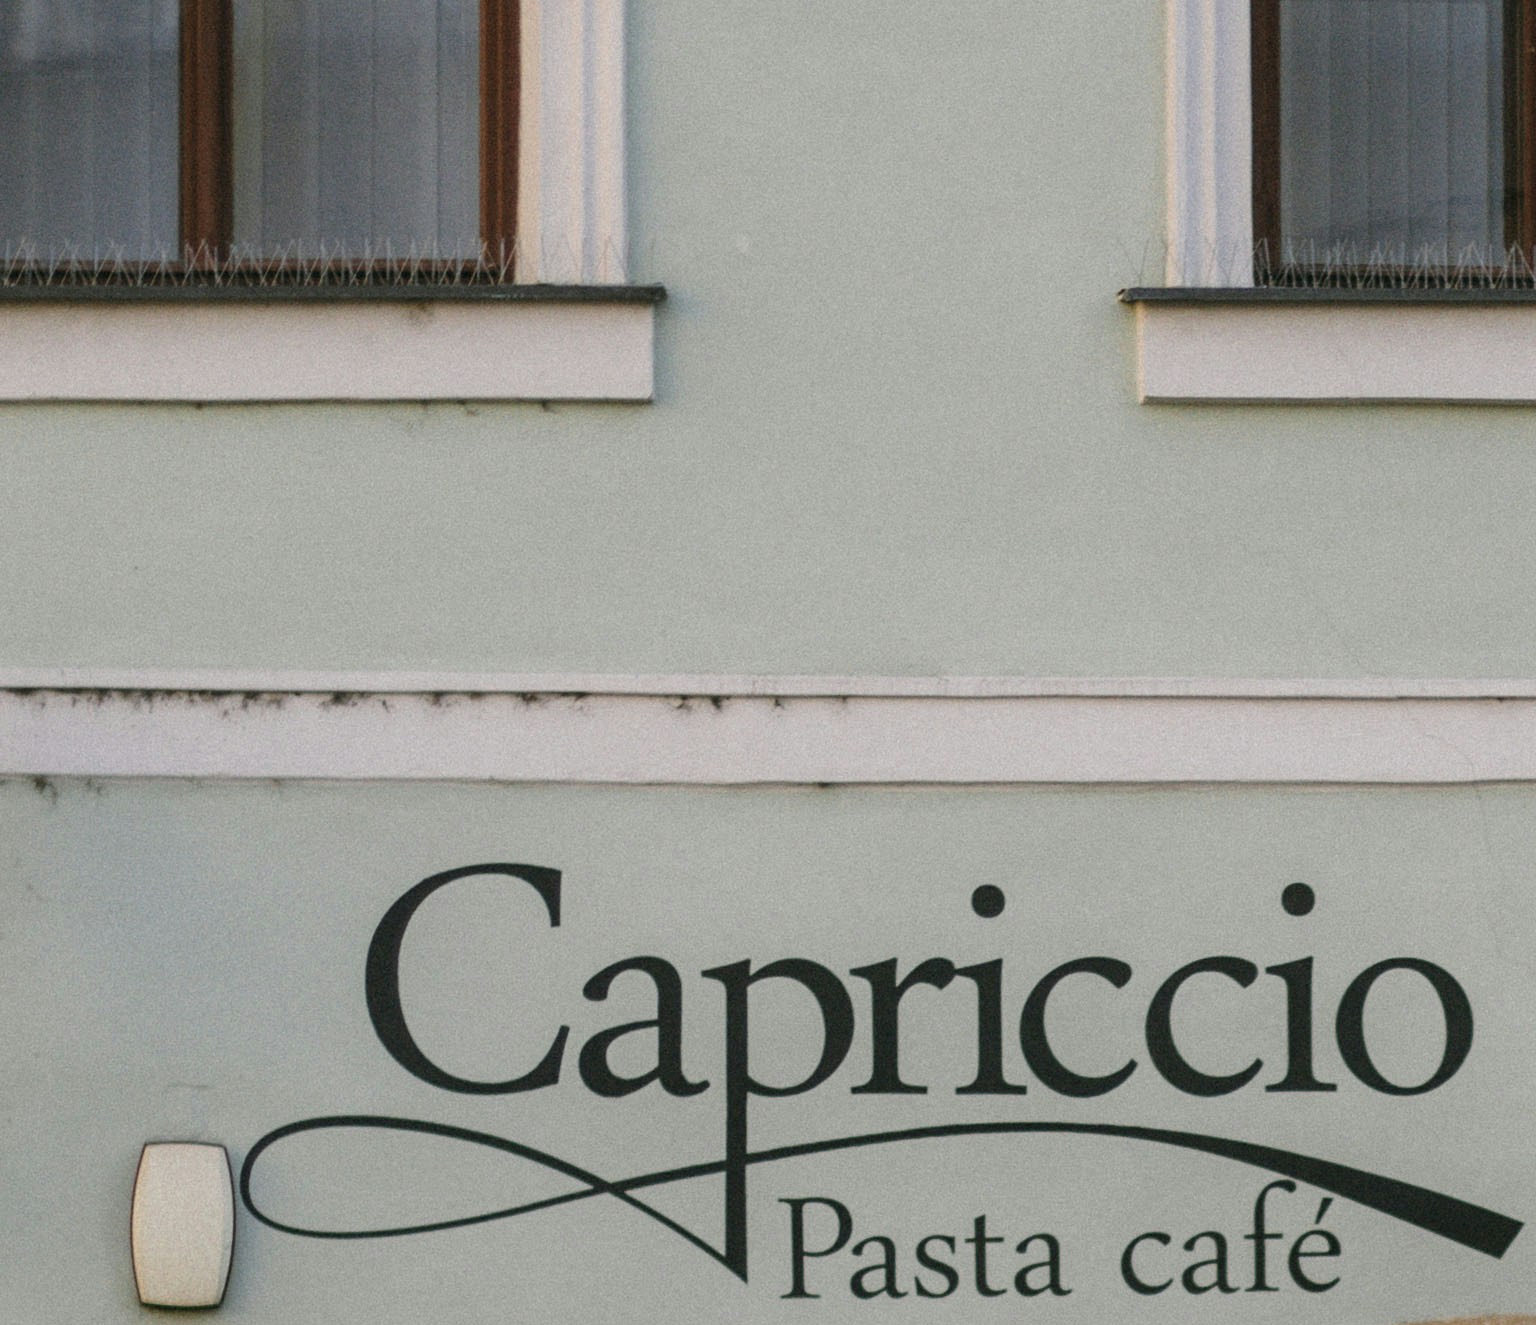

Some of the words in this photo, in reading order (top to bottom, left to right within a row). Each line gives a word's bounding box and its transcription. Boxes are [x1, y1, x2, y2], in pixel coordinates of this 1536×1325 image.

[364, 862, 1475, 1285] Capriccio
[777, 1196, 1072, 1300] Pasta
[1120, 1180, 1342, 1295] café
